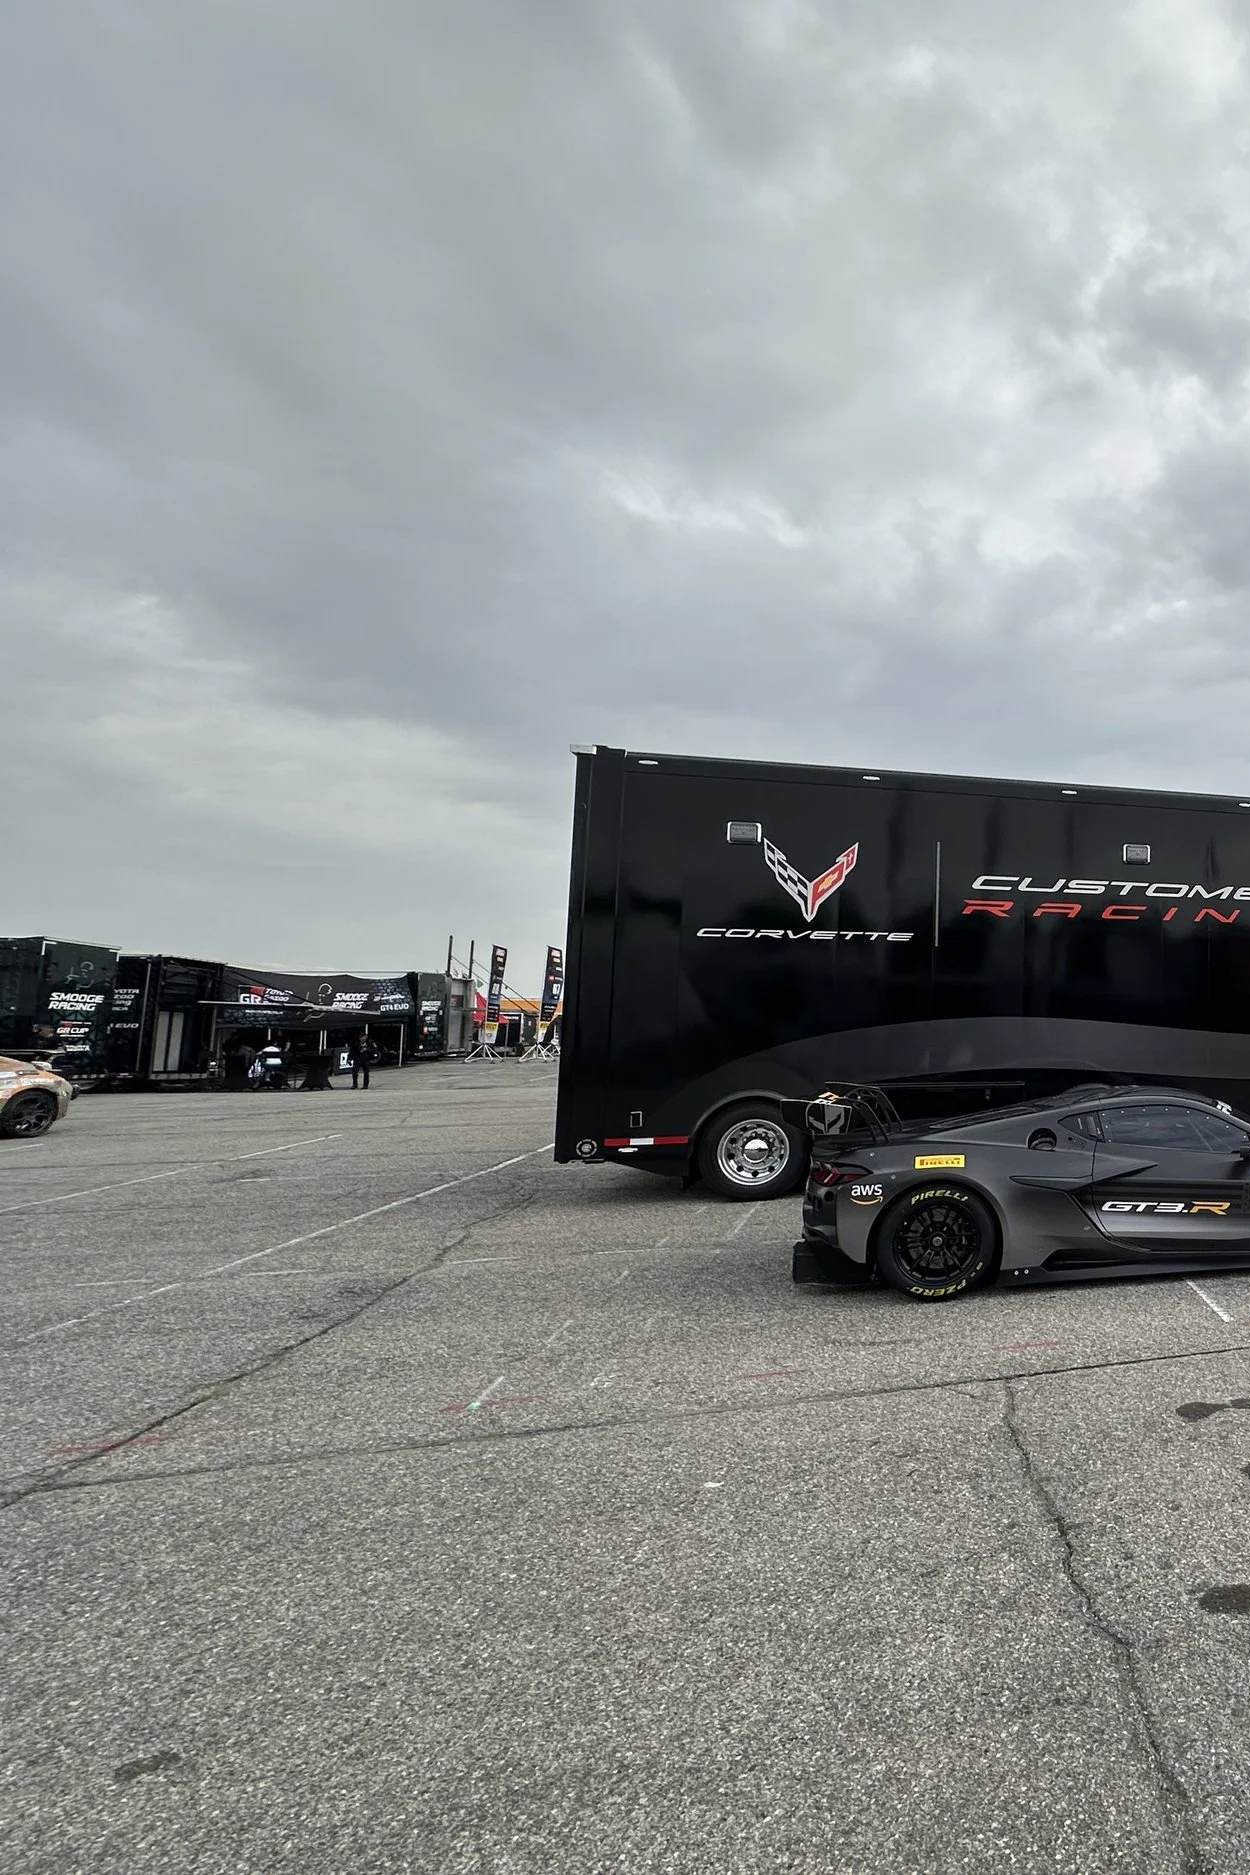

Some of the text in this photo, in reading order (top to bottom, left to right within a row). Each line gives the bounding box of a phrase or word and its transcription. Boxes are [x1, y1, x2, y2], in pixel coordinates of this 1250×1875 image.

[697, 928, 914, 941] CORVETTE
[49, 992, 104, 1003] SMOOGE
[239, 994, 262, 1004] GR
[333, 993, 369, 1001] SMOOGE
[48, 1001, 97, 1011] RACING
[332, 1001, 364, 1009] RACING
[851, 1184, 883, 1196] aws
[911, 1190, 968, 1205] PIRELLI
[1101, 1201, 1231, 1215] GT3.R
